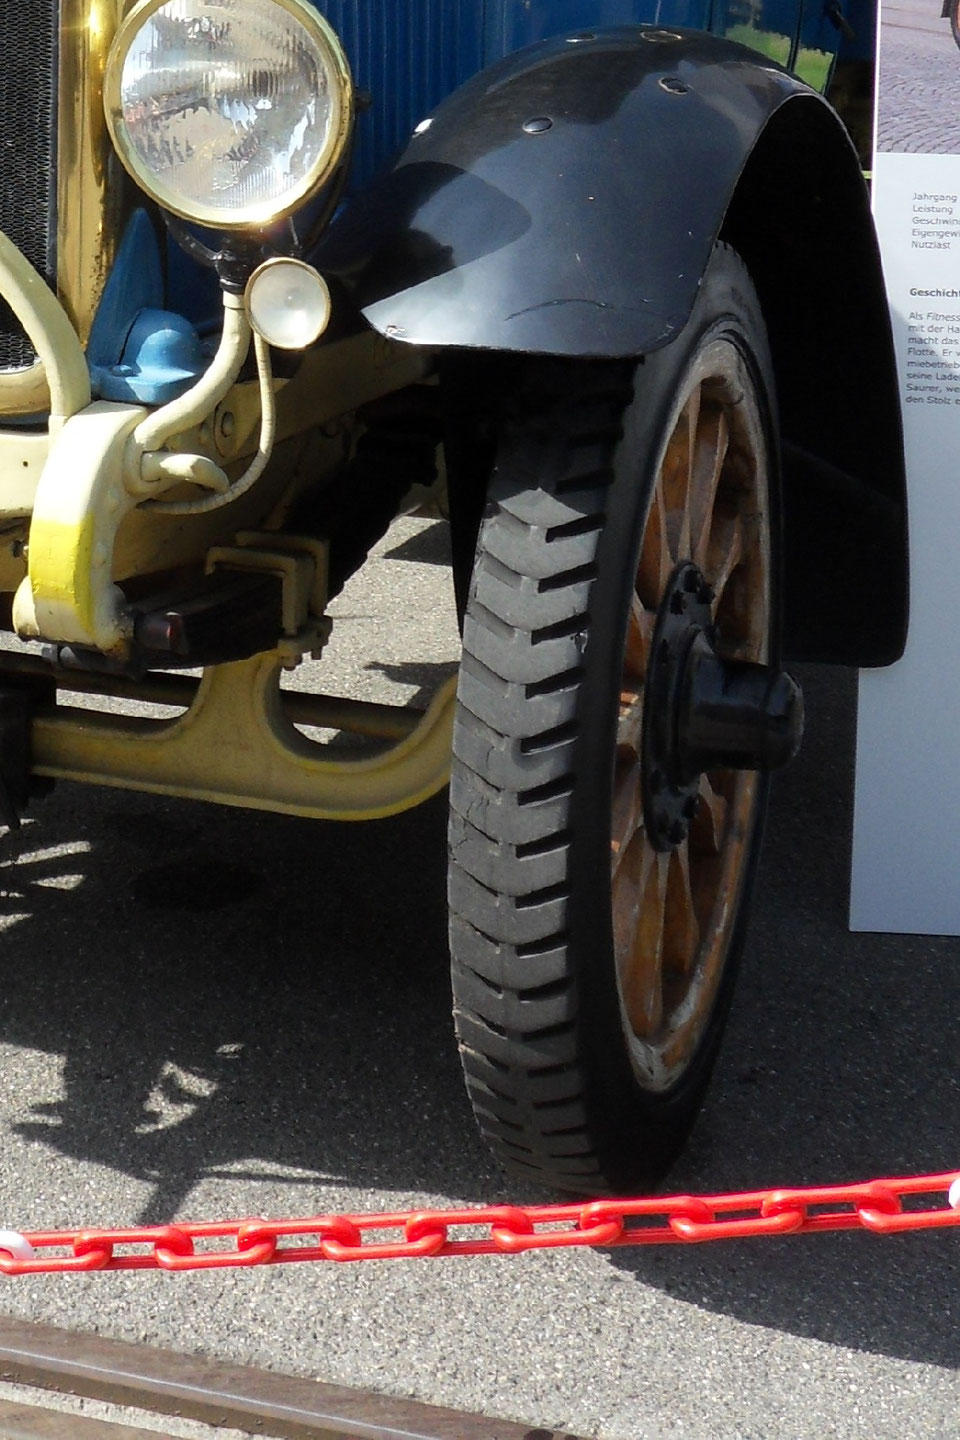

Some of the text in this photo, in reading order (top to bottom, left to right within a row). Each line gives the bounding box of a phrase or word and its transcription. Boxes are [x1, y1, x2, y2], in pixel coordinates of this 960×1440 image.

[912, 192, 958, 204] Jahrgang
[912, 204, 954, 216] Leistung
[911, 240, 951, 250] Nutzlast
[908, 311, 924, 321] Als
[908, 324, 926, 333] mit
[927, 324, 944, 333] der
[907, 336, 959, 345] macht das
[907, 347, 953, 357] Flotte. Er
[906, 371, 960, 381] seine Lade
[906, 383, 943, 394] Saurer,
[905, 395, 924, 404] den
[926, 396, 952, 405] Stolz
